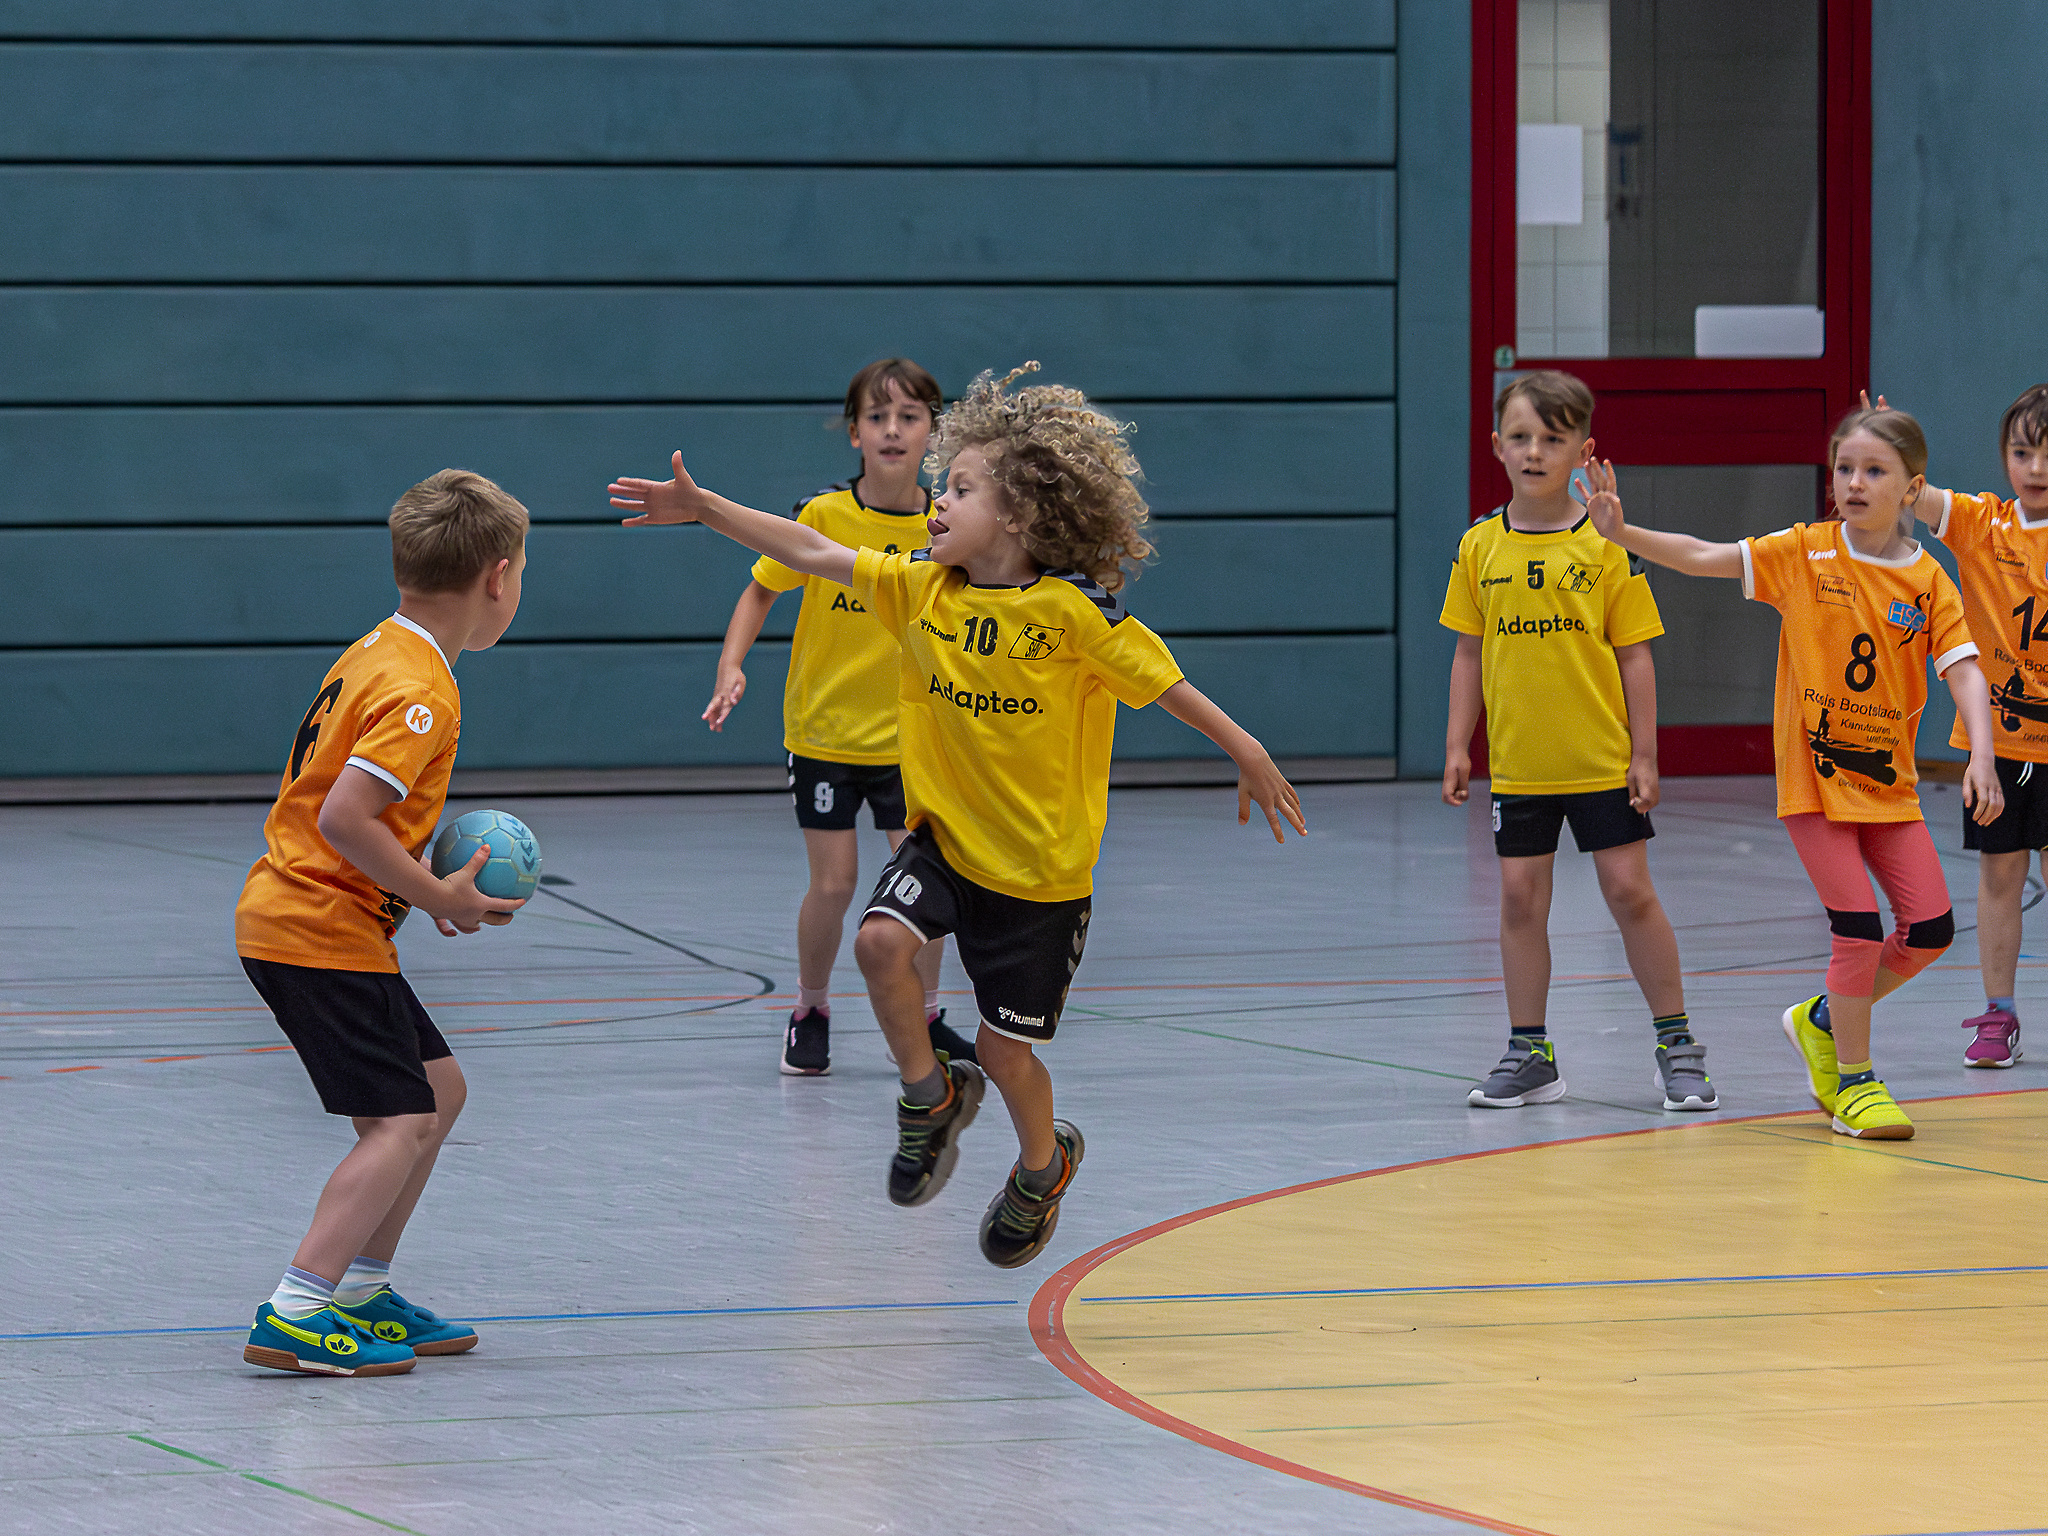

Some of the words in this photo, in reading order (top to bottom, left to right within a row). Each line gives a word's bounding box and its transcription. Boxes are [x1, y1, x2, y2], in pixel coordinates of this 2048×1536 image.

[1527, 560, 1546, 590] 5
[1496, 614, 1589, 639] Adapteo.
[1889, 602, 1925, 630] HSG
[963, 616, 999, 656] 10
[1844, 633, 1877, 693] 8
[928, 672, 1044, 718] Adapteo.
[814, 781, 835, 814] 9
[1492, 801, 1502, 833] 5
[881, 868, 923, 906] 10
[1009, 1010, 1046, 1027] hummel
